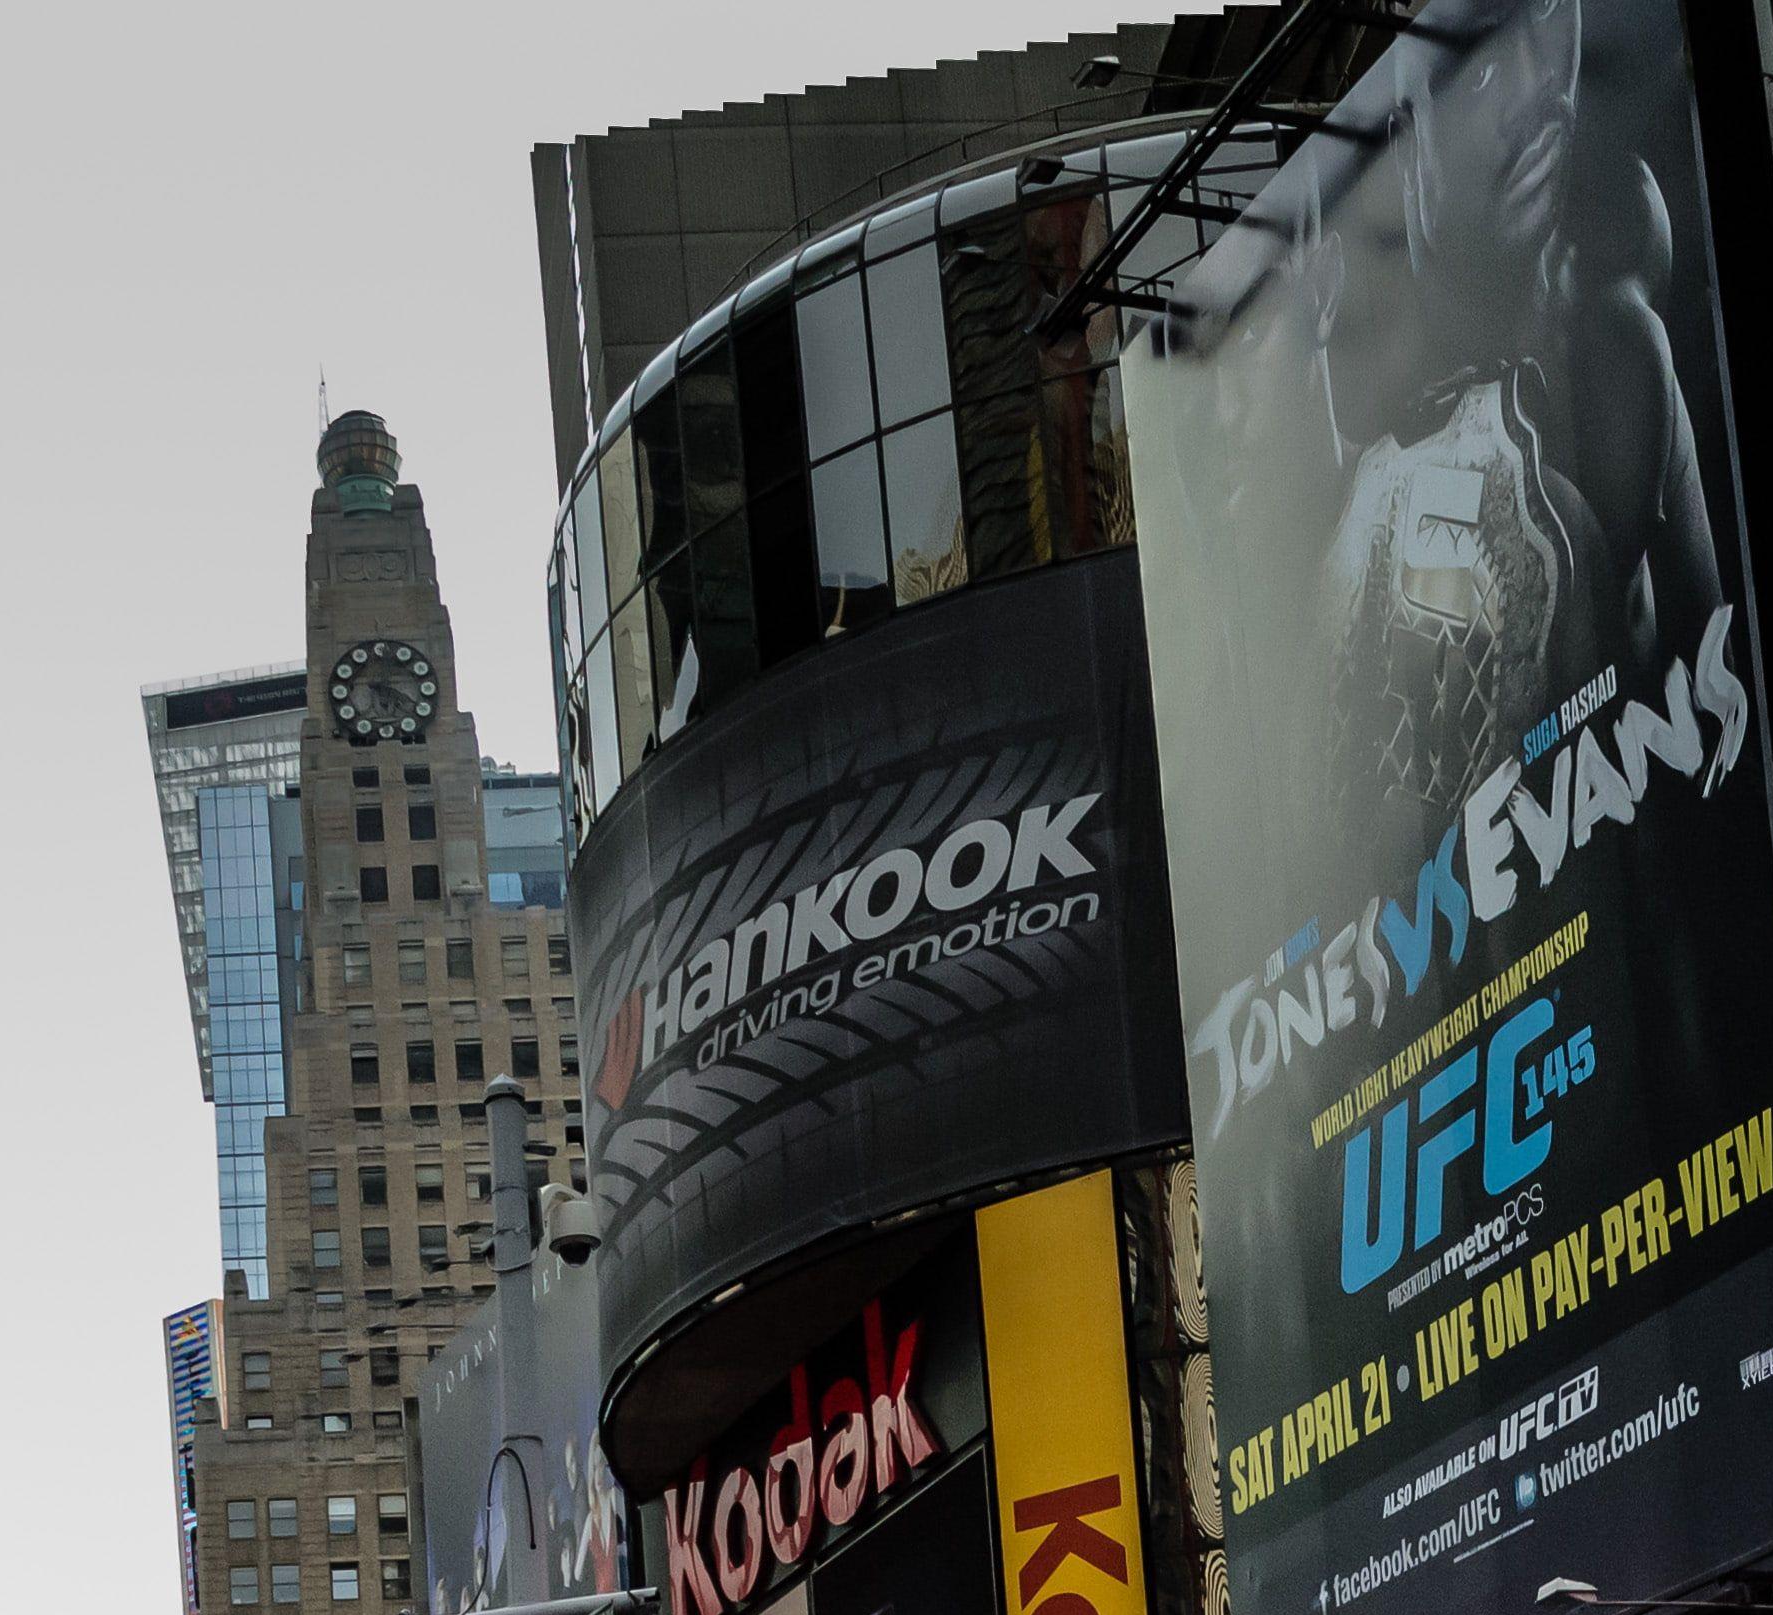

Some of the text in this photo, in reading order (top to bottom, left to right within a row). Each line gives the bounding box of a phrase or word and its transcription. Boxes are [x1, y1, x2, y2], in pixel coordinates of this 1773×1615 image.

[697, 889, 1100, 1073] driving emotion
[1191, 604, 1749, 1142] JONES VS EVANS
[1311, 909, 1590, 1149] WORLD LIGHT HEAVYWEIGHT CHAMPIONSHIP
[1341, 998, 1595, 1294] UFC 145
[1229, 1108, 1773, 1514] SAT APRIL 21 LIVE ON PAY-PER-VIEW
[1443, 1183, 1544, 1276] metroPCS
[1333, 1382, 1700, 1607] facebook.com/UFC twitter.com/ufc
